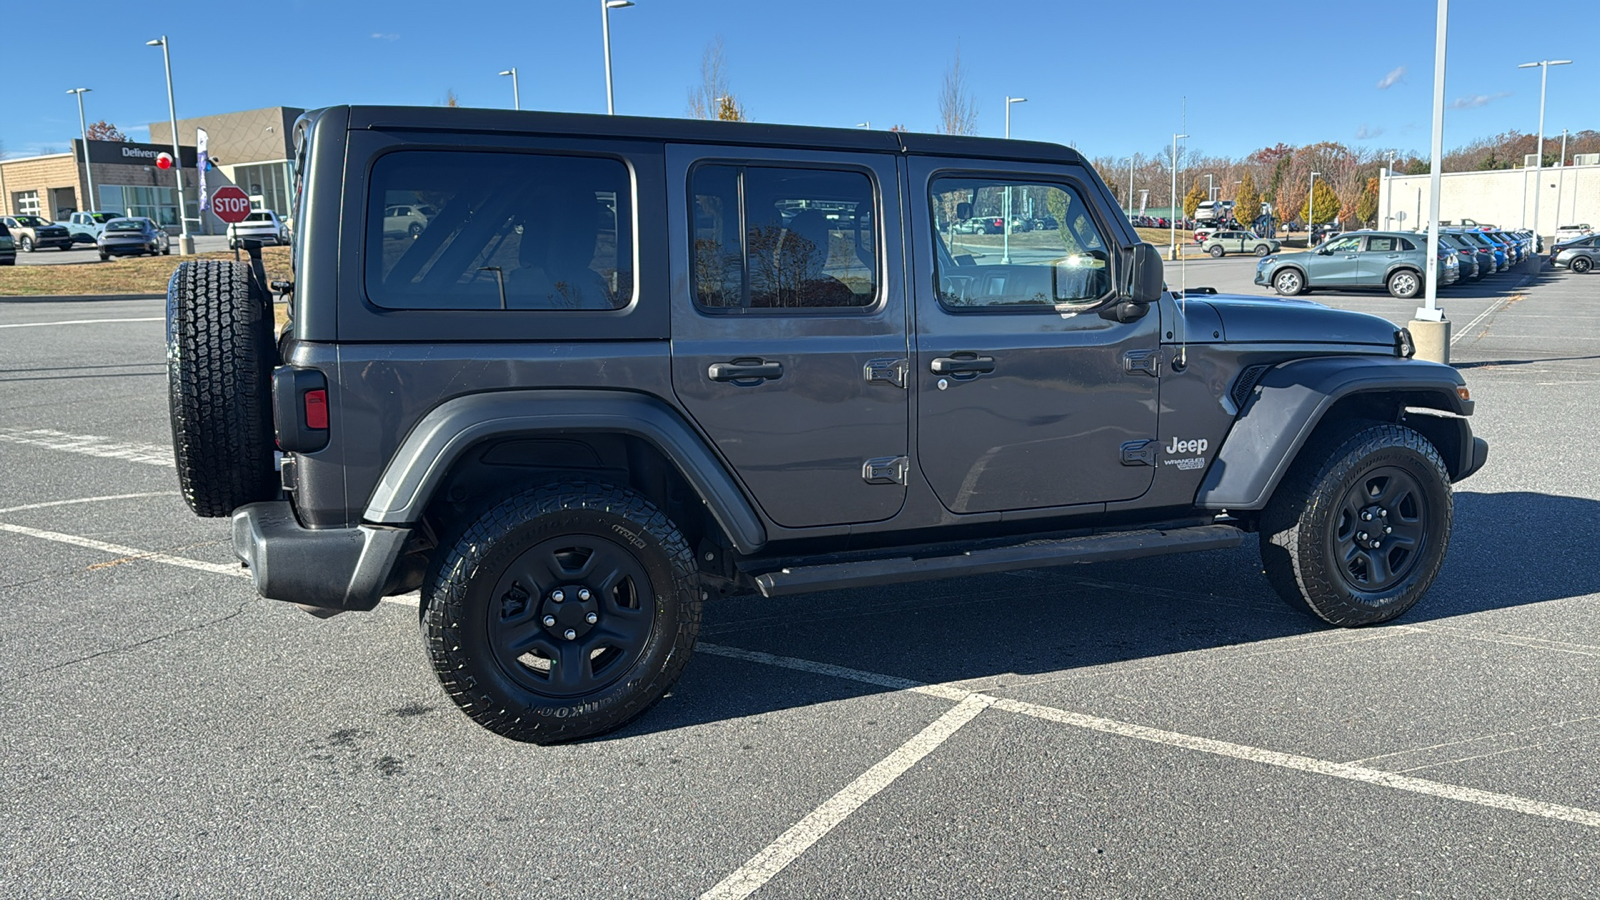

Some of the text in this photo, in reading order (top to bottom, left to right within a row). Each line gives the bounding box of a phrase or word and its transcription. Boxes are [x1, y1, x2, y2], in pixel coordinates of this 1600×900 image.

[122, 147, 159, 160] Delivery
[215, 197, 249, 213] STOP
[1166, 436, 1208, 455] Jeep
